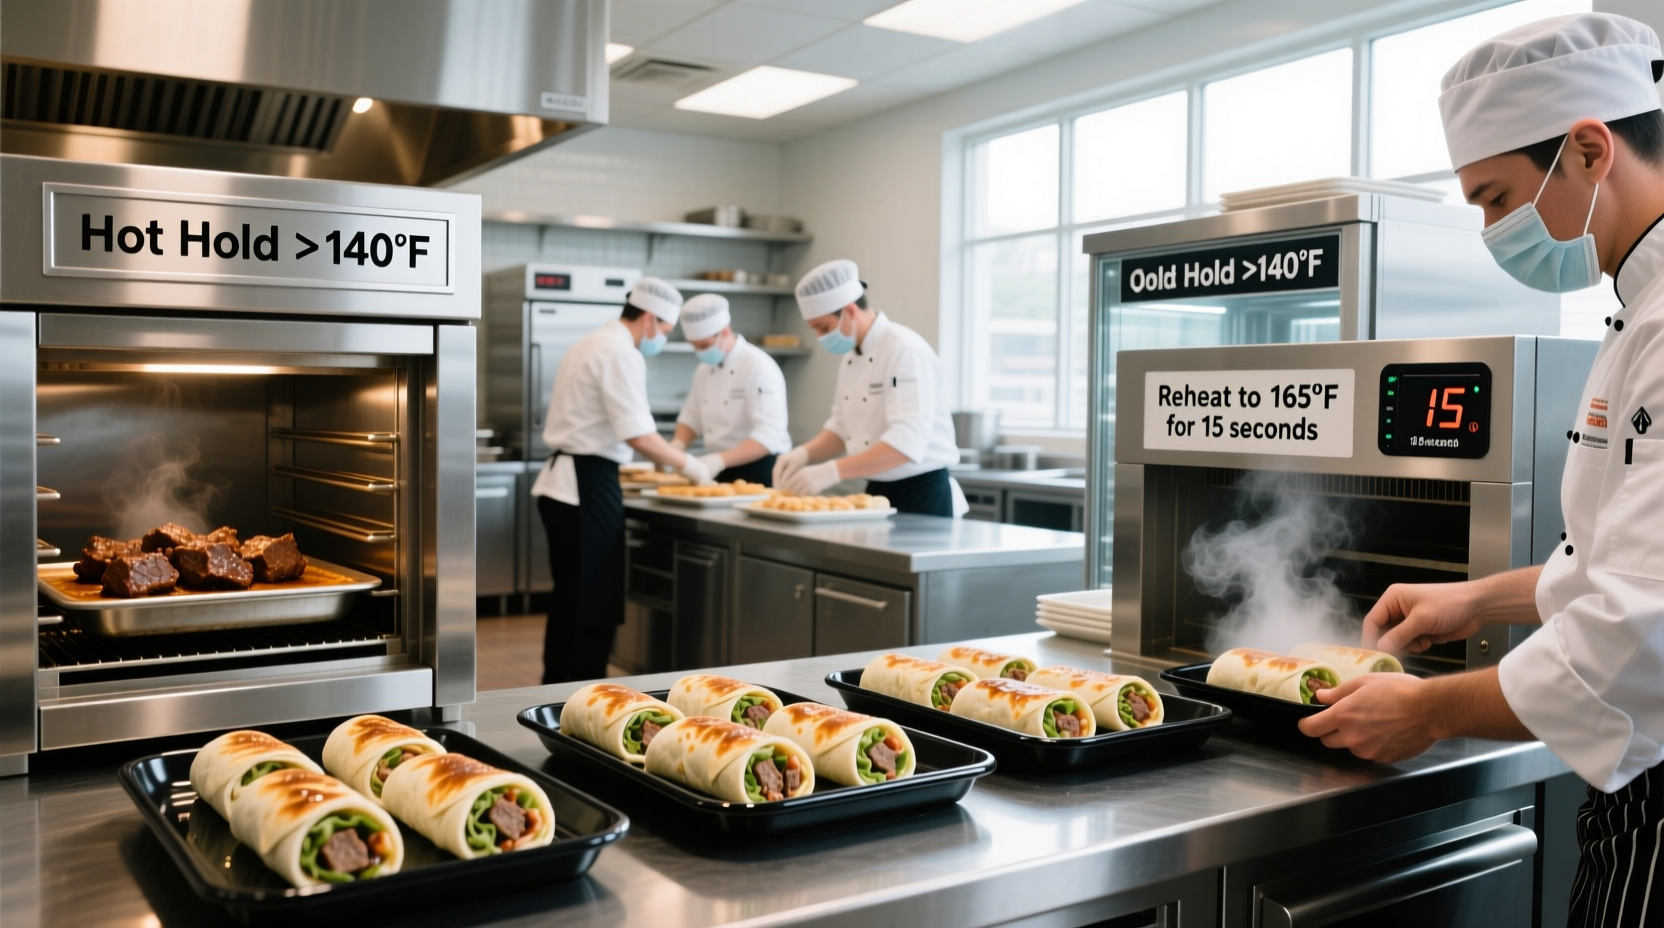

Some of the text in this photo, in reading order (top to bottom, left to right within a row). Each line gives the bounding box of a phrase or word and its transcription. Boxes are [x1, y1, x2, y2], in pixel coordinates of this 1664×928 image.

[82, 213, 164, 255] Hot
[180, 219, 279, 261] Hold
[1184, 257, 1235, 287] Hold
[1158, 383, 1339, 409] Reheat to 165°F
[1426, 387, 1466, 428] 15
[1166, 413, 1319, 441] for 15 seconds
